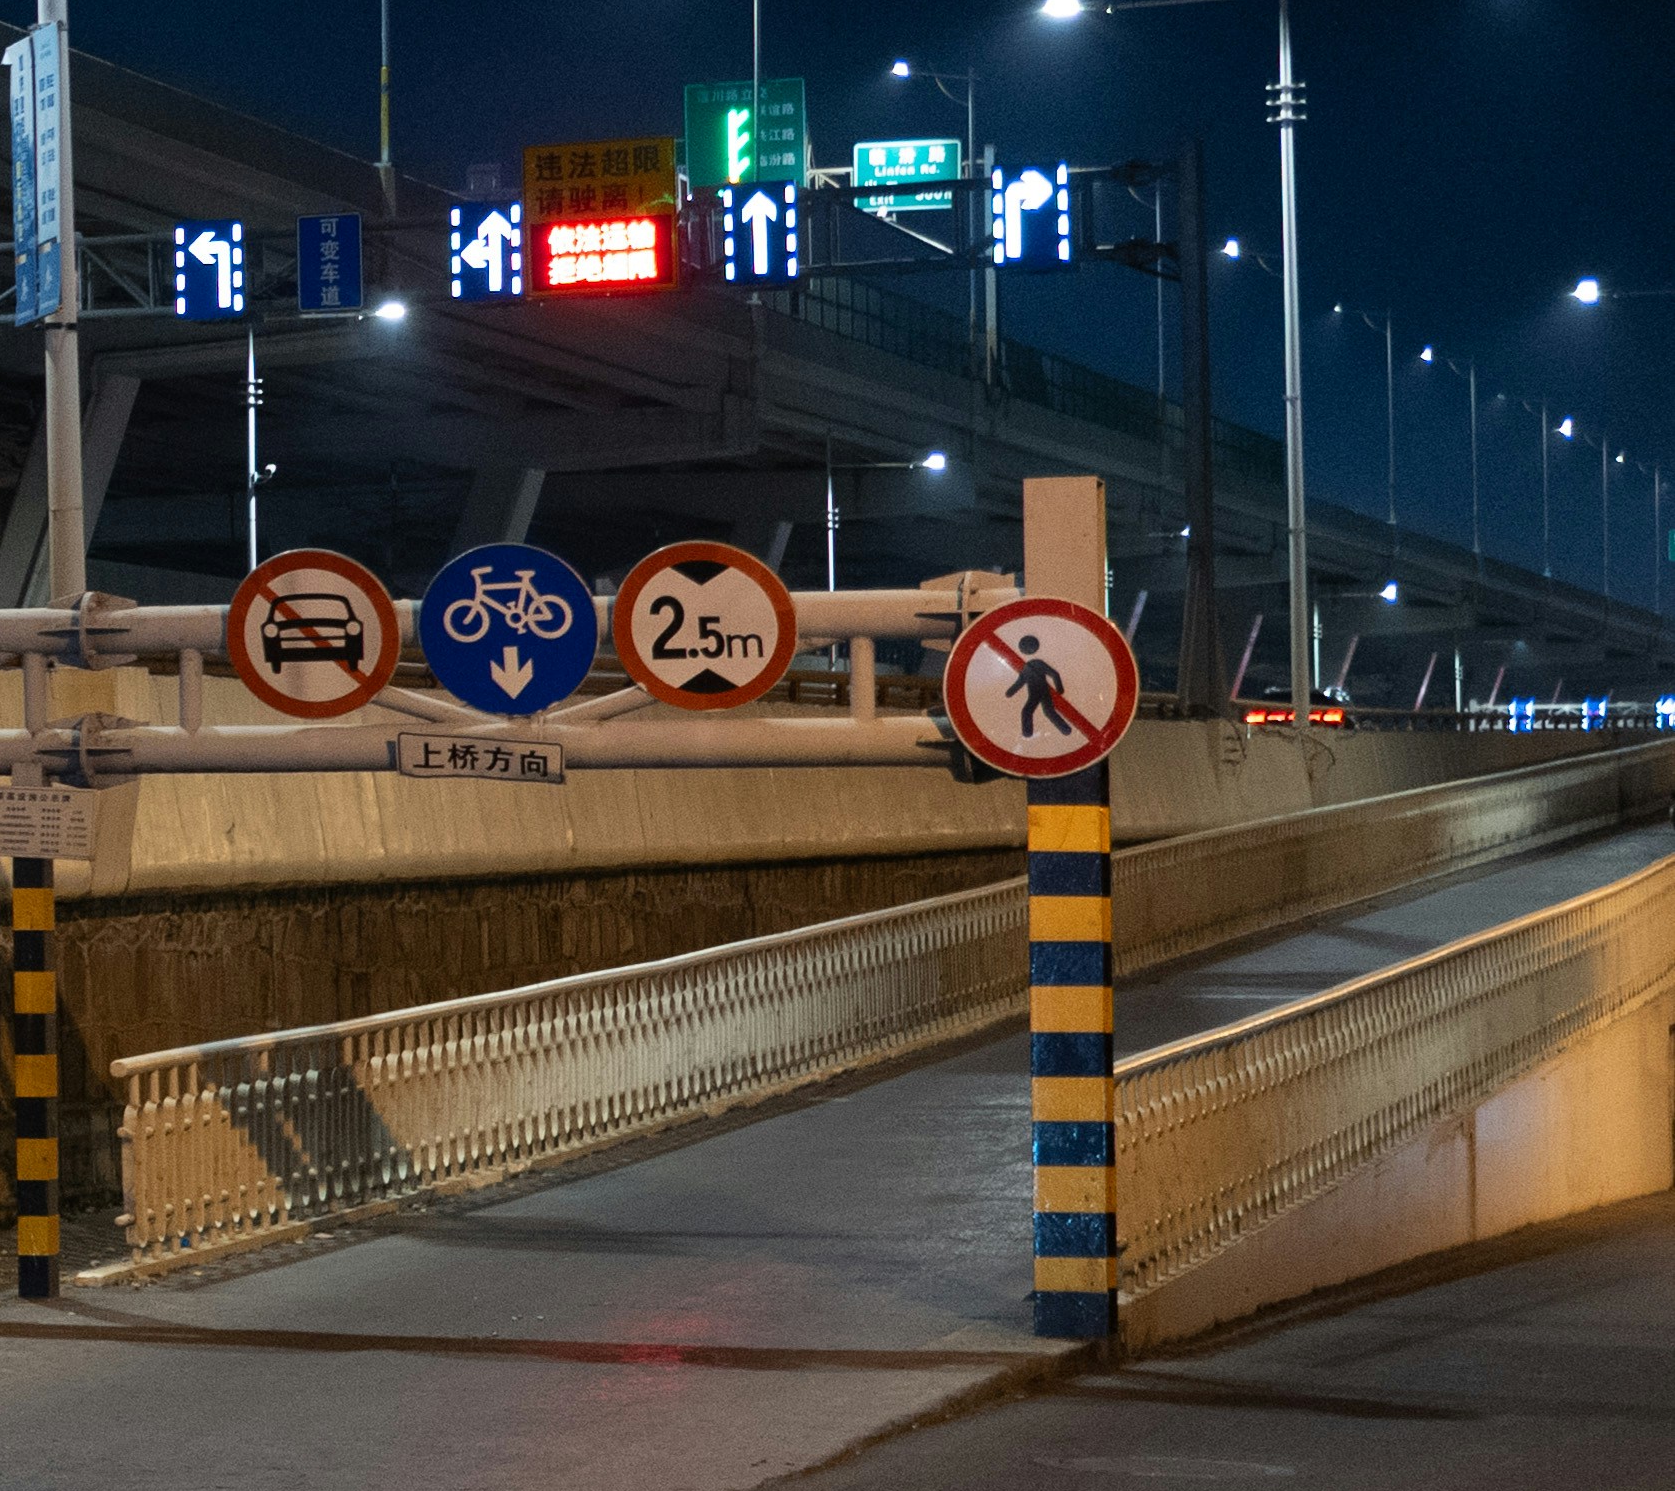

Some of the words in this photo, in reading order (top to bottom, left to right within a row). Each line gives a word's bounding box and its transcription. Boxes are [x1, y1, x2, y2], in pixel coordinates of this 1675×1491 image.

[535, 144, 661, 181] 违法超限
[874, 165, 915, 178] Linfen
[920, 163, 941, 175] Rd.
[319, 217, 342, 306] 可变车道
[649, 595, 764, 660] 2.5m
[413, 742, 549, 777] 上桥方向
